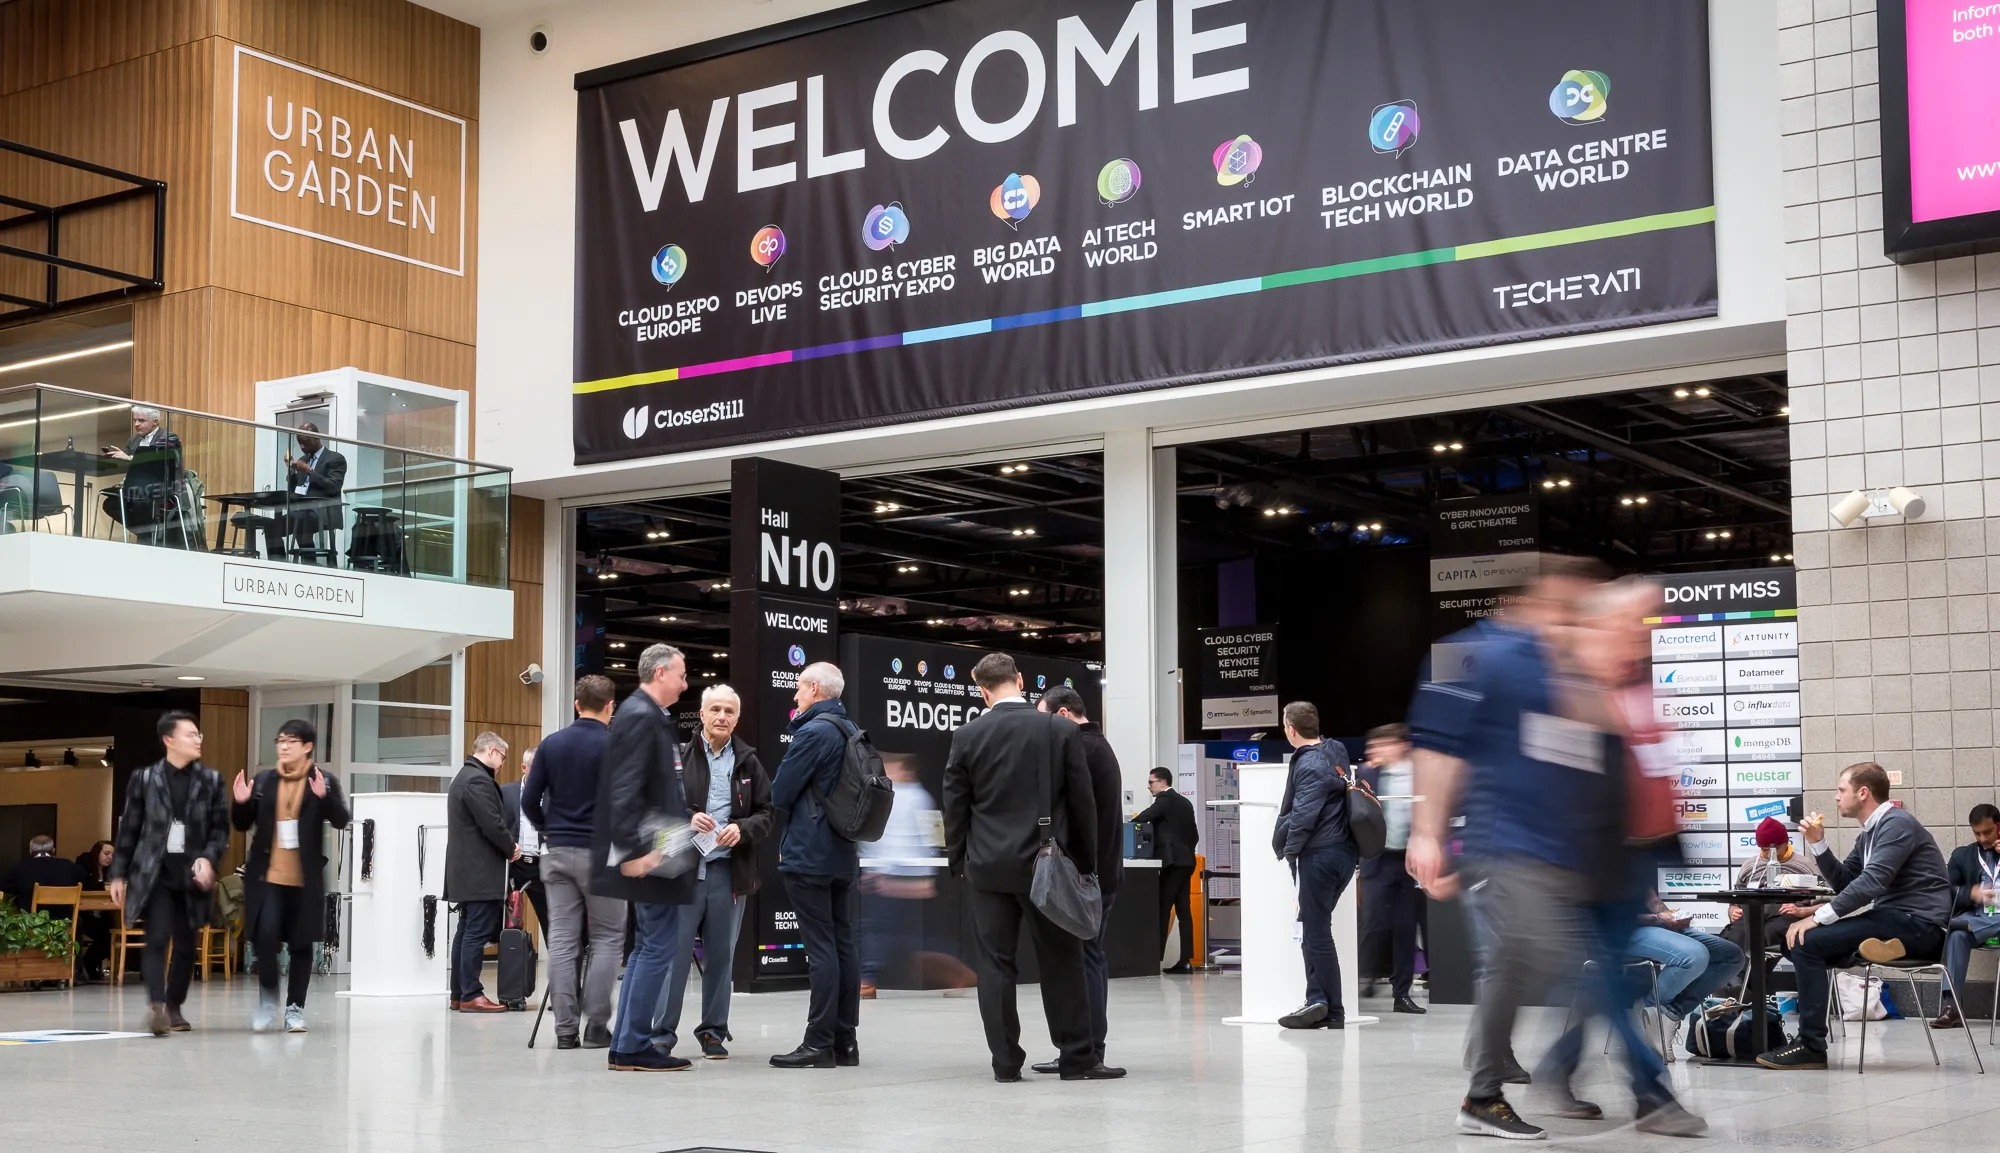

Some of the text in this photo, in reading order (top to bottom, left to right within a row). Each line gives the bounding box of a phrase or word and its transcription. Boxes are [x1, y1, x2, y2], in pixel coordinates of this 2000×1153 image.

[1953, 23, 1993, 43] both
[619, 0, 1249, 213] WELCOME
[266, 95, 414, 179] URBAN
[1498, 128, 1667, 177] DATA CENTRE
[1321, 163, 1472, 206] BLOCKCHAIN
[1534, 159, 1629, 192] WORLD
[264, 150, 436, 235] GARDEN
[1182, 194, 1295, 231] SMART IOT
[1321, 187, 1474, 230] TECH WORLD
[1081, 219, 1156, 248] AI TECH
[973, 235, 1062, 267] BIG DATA
[1084, 241, 1158, 269] WORLD
[819, 255, 956, 293] CLOUD & CYBER
[981, 257, 1055, 285] WORLD
[735, 281, 803, 308] DEVOPS
[820, 274, 955, 312] SECURITY EXPO
[1493, 267, 1641, 309] TECHERATI
[618, 295, 720, 326] CLOUD EXPO
[751, 304, 787, 325] LIVE
[636, 316, 702, 342] EUROPE
[654, 399, 744, 430] CloserStill
[761, 507, 789, 529] Hall
[1440, 504, 1530, 520] CYBER INNOVATIONS
[1451, 517, 1517, 530] & GRC THEATRE
[1498, 538, 1534, 546] TECHERATI
[761, 532, 835, 592] N10
[1437, 570, 1477, 581] CAPITA
[233, 577, 355, 605] URBAN GARDEN
[1664, 581, 1781, 603] DON'T MISS
[1440, 598, 1483, 609] SECURITY
[1484, 598, 1497, 606] OF
[1465, 609, 1504, 618] THEATRE
[765, 611, 828, 634] WELCOME
[1204, 632, 1273, 645] CLOUD & CYBER
[1658, 632, 1716, 645] Acrotrend
[1744, 632, 1790, 642] ATTUNITY
[1217, 645, 1261, 656] SECURITY
[1218, 657, 1260, 668] KEYNOTE
[1739, 669, 1784, 678] Datameer
[772, 670, 795, 680] CLOUD
[772, 679, 799, 689] SECURI
[1219, 669, 1259, 679] THEATRE
[1677, 674, 1717, 683] Barracuda
[887, 699, 962, 732] BADGE
[1662, 702, 1715, 716] Exasol
[780, 734, 794, 743] SMA
[1743, 738, 1791, 749] mongoDB
[1737, 770, 1791, 782] neustar
[1682, 840, 1720, 850] nowflake
[775, 921, 793, 930] TECH
